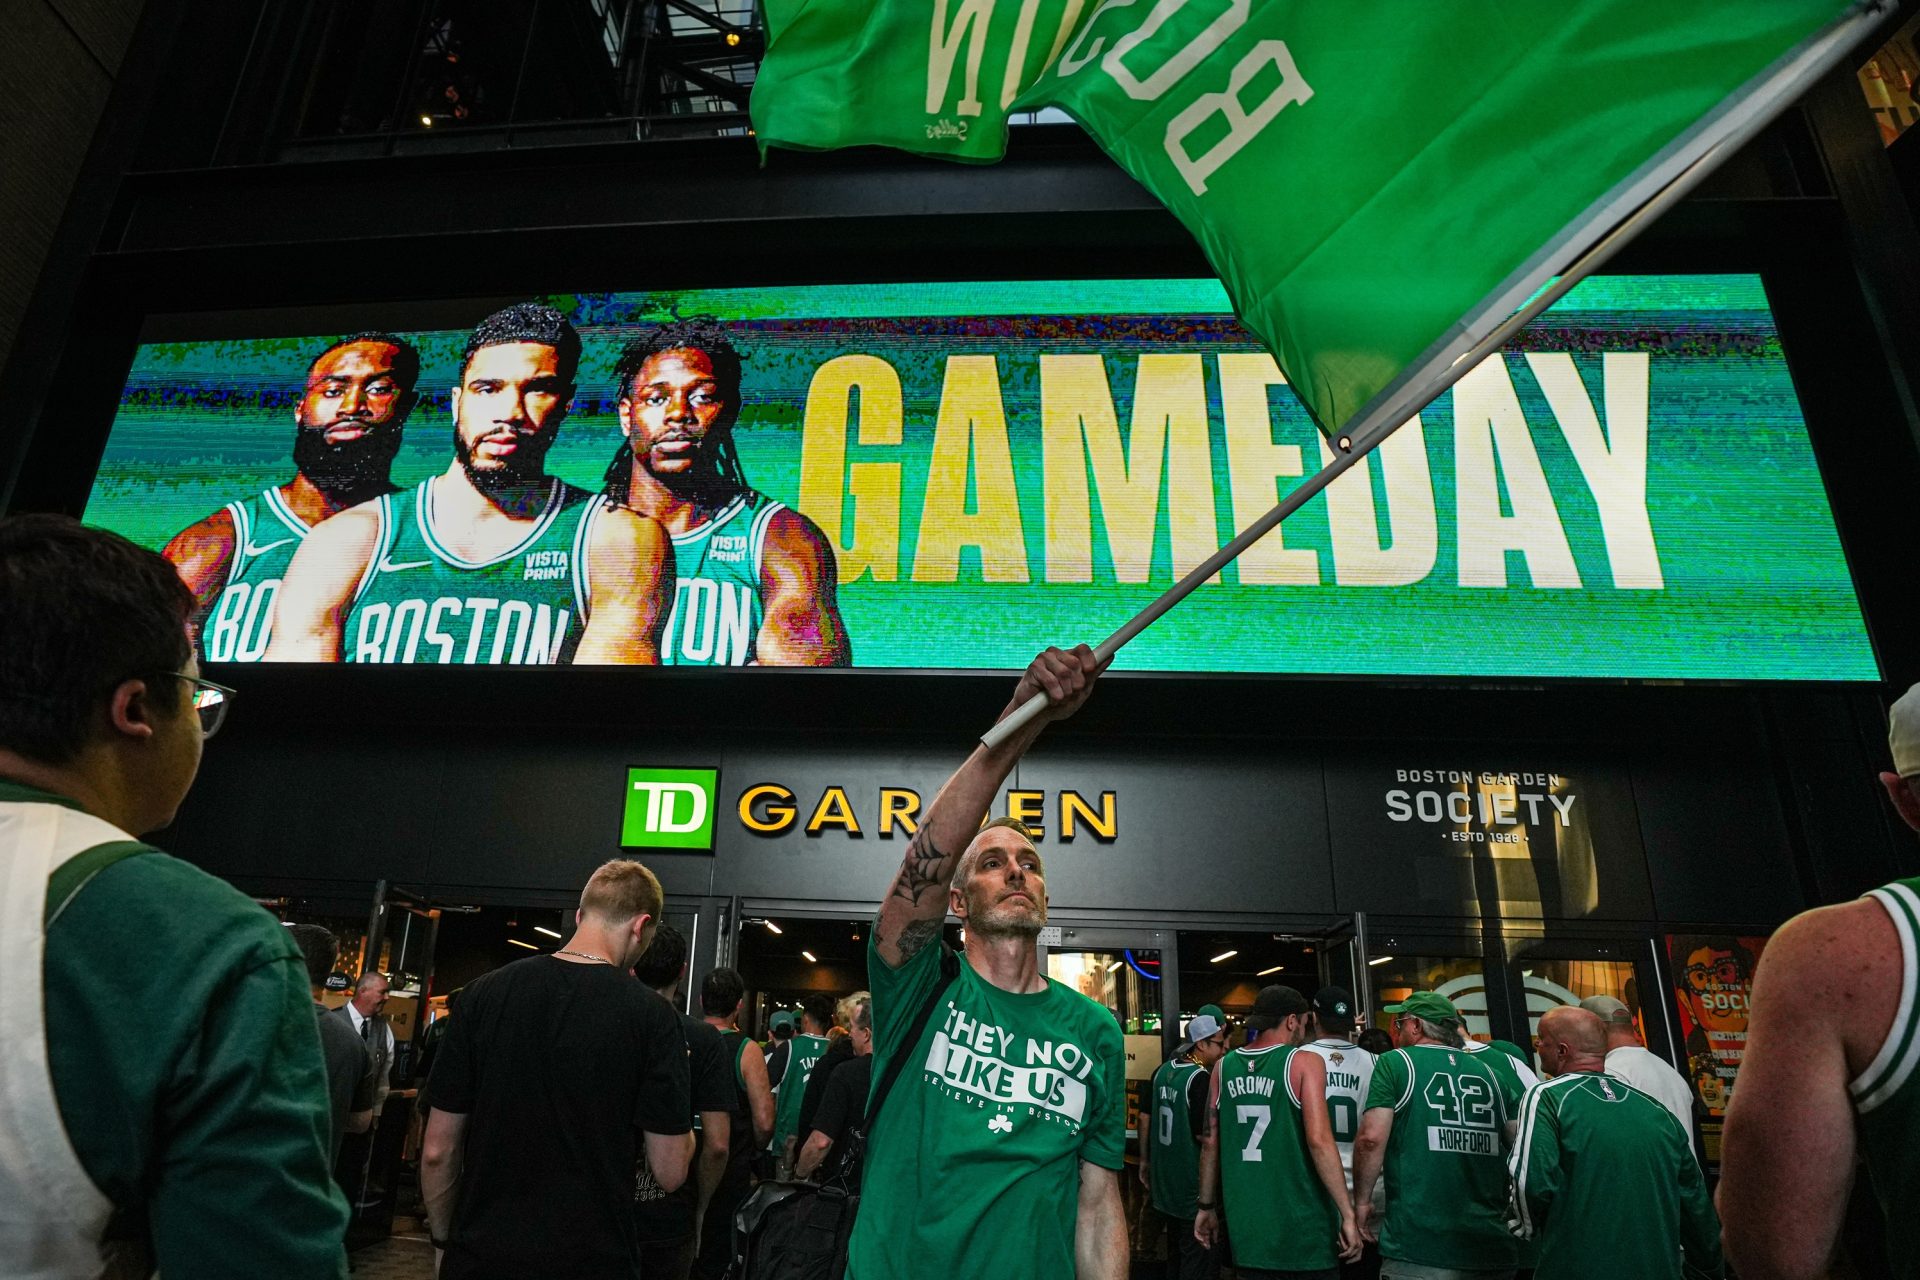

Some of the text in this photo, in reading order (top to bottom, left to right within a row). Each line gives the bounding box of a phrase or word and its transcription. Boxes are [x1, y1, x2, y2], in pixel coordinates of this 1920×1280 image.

[799, 351, 1665, 591] GAMEDAY
[526, 551, 568, 568] VISTA
[709, 550, 746, 562] PRINT
[711, 535, 747, 550] VISTA
[524, 566, 567, 580] PRINT
[356, 597, 570, 664] BOSTON
[661, 577, 752, 666] TON
[1396, 769, 1560, 787] BOSTON GARDEN
[633, 781, 1117, 843] TD GAREN
[1385, 789, 1576, 827] SOCIETY
[1451, 831, 1520, 843] ESTD 1928
[1701, 993, 1751, 1010] SOCI
[943, 1001, 1015, 1058] THEY
[944, 1047, 1065, 1107] LIKE US
[1227, 1076, 1275, 1098] BROWN
[998, 1104, 1015, 1113] IN
[1327, 1095, 1358, 1143] 0
[1424, 1072, 1495, 1128] 42
[1159, 1105, 1174, 1146] 0
[1236, 1105, 1271, 1161] 7
[1438, 1128, 1491, 1153] HORFORD
